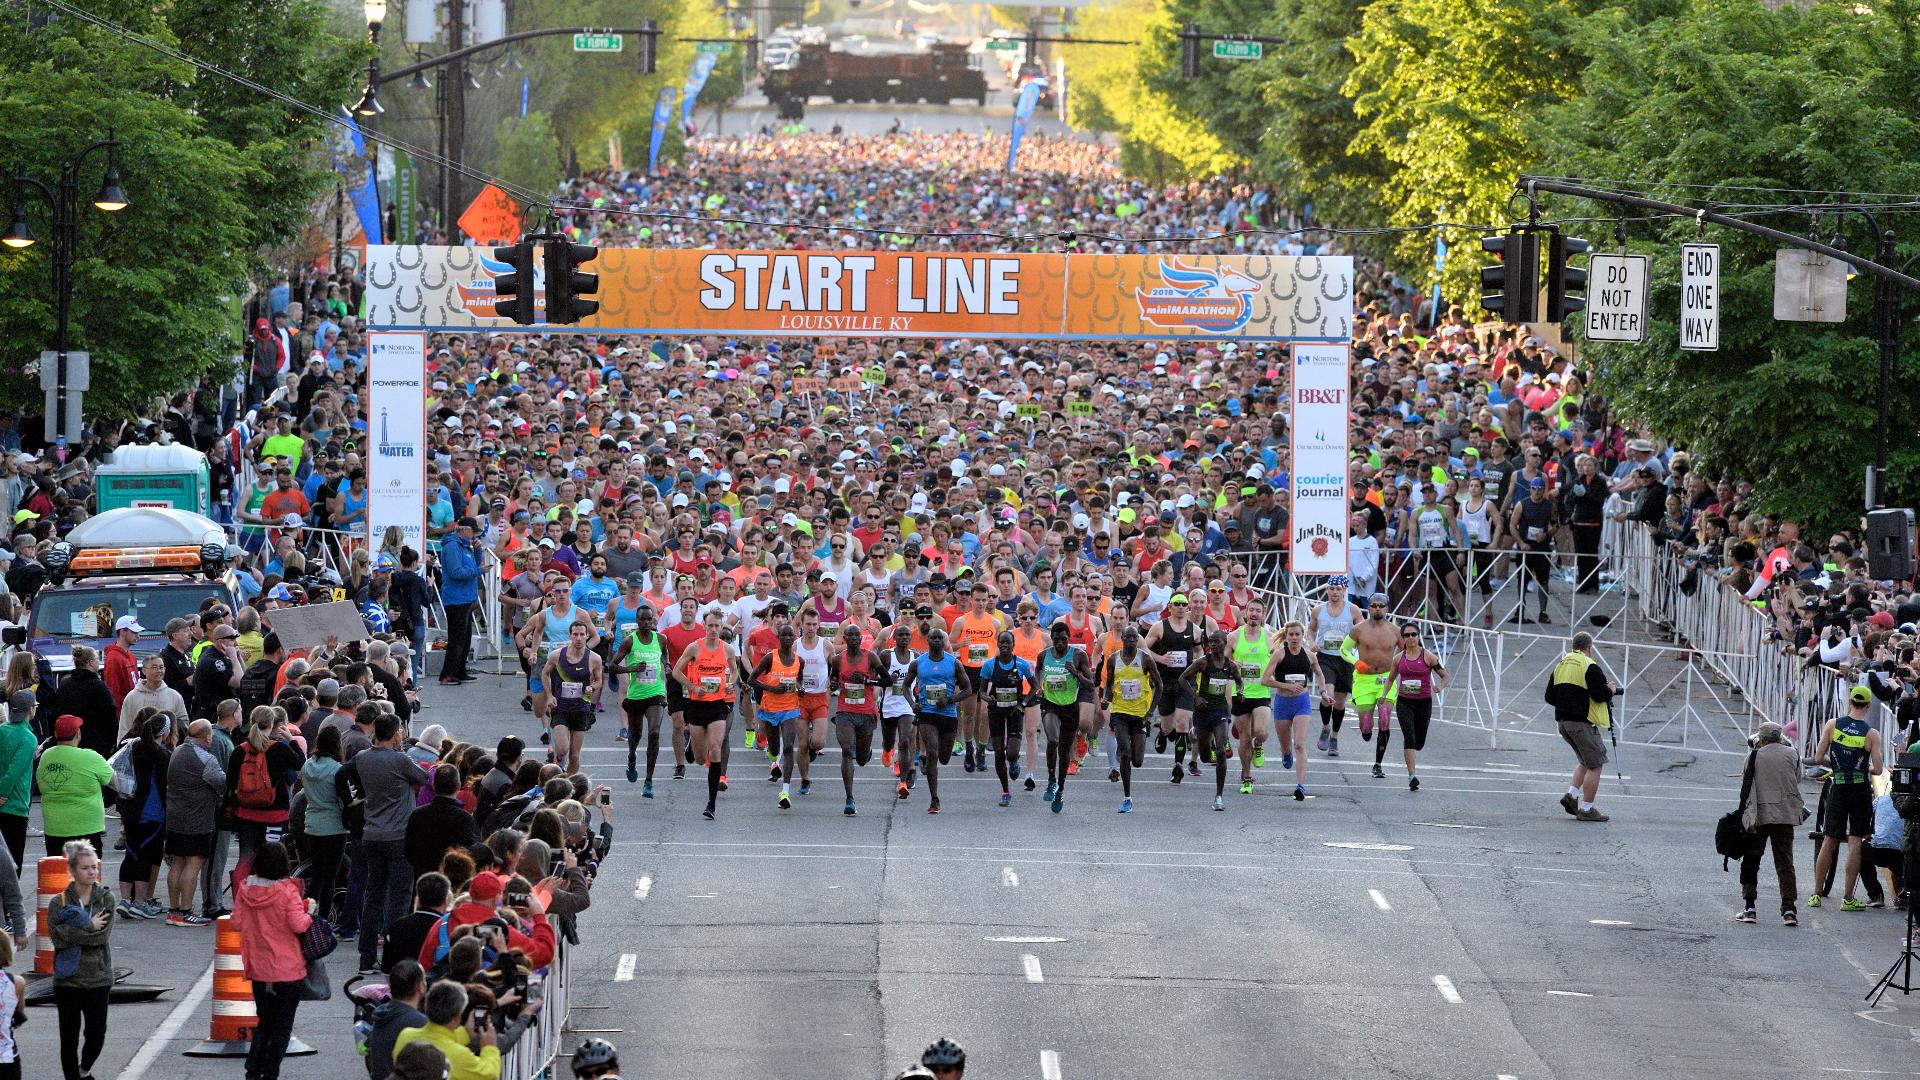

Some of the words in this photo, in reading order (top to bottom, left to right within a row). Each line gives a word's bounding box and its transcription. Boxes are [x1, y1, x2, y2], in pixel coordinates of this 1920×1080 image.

[587, 37, 609, 48] FLOYD
[1227, 44, 1249, 56] FLOYD
[1687, 252, 1713, 277] END
[1607, 265, 1628, 284] DO
[699, 253, 876, 312] START
[896, 256, 1021, 315] LINE
[1601, 289, 1632, 307] NOT
[1686, 285, 1713, 310] ONE
[1146, 305, 1236, 315] miniMARATHON
[889, 317, 913, 331] KY
[1590, 312, 1639, 331] ENTER
[1685, 318, 1713, 342] WAY
[1297, 388, 1345, 404] BB&T
[378, 447, 415, 457] WATER
[1296, 474, 1345, 485] courier
[1296, 486, 1344, 499] journal
[375, 525, 421, 533] BAMAN
[1296, 527, 1314, 544] JIM
[1315, 523, 1343, 544] BEAM
[336, 590, 342, 599] A
